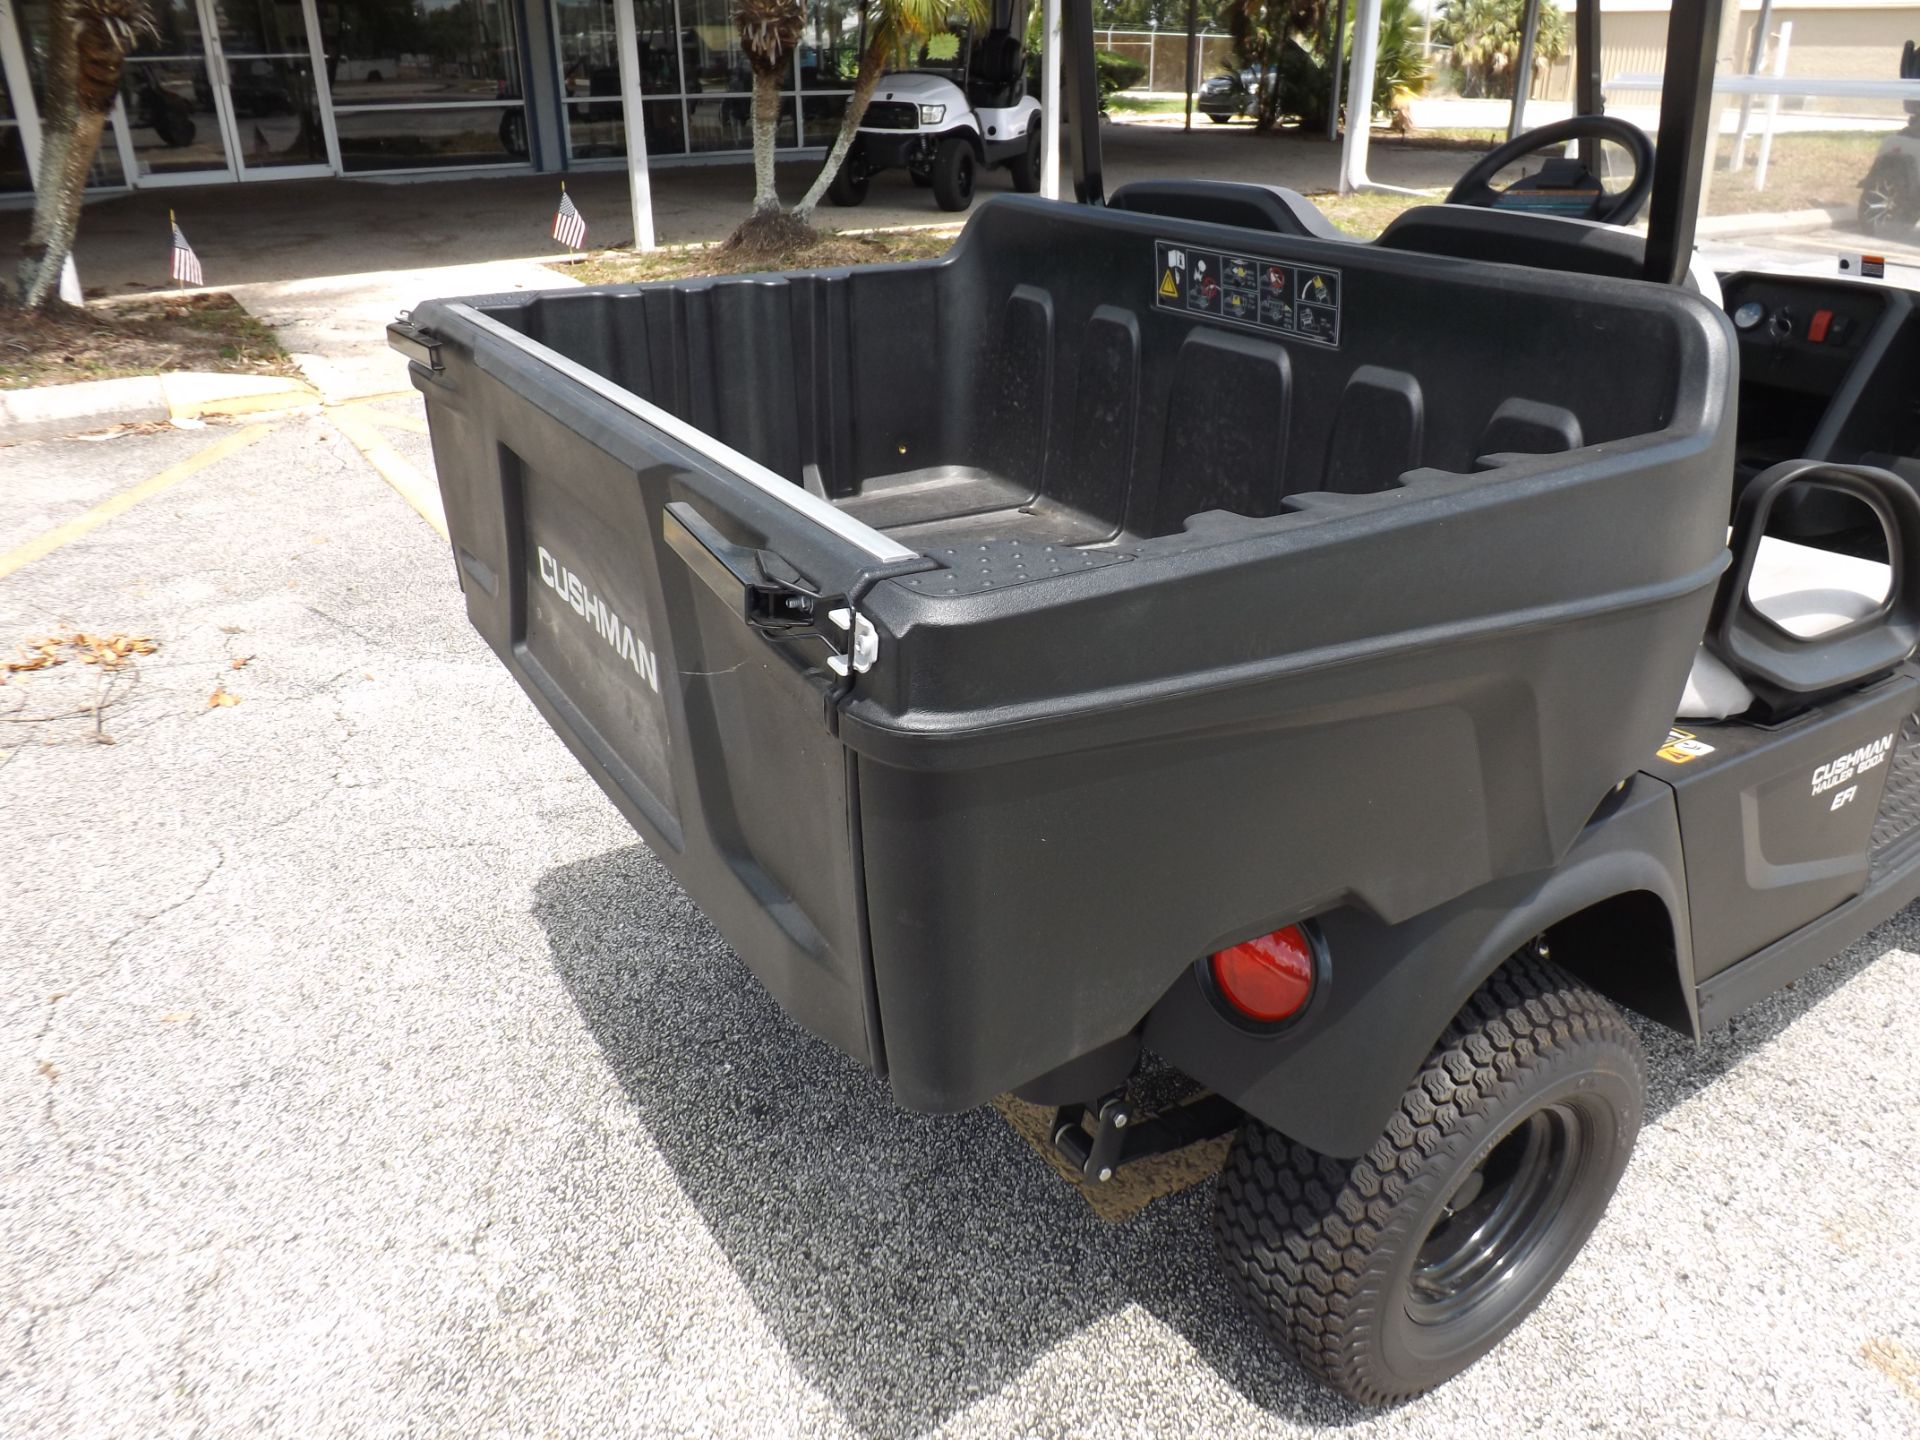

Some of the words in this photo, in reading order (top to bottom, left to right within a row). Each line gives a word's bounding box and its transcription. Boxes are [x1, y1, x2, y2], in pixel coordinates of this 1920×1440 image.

[538, 546, 658, 694] CUSHMAN
[1811, 733, 1893, 785] CUSHMAN
[1811, 767, 1854, 796] HAULER
[1830, 785, 1858, 811] EFI
